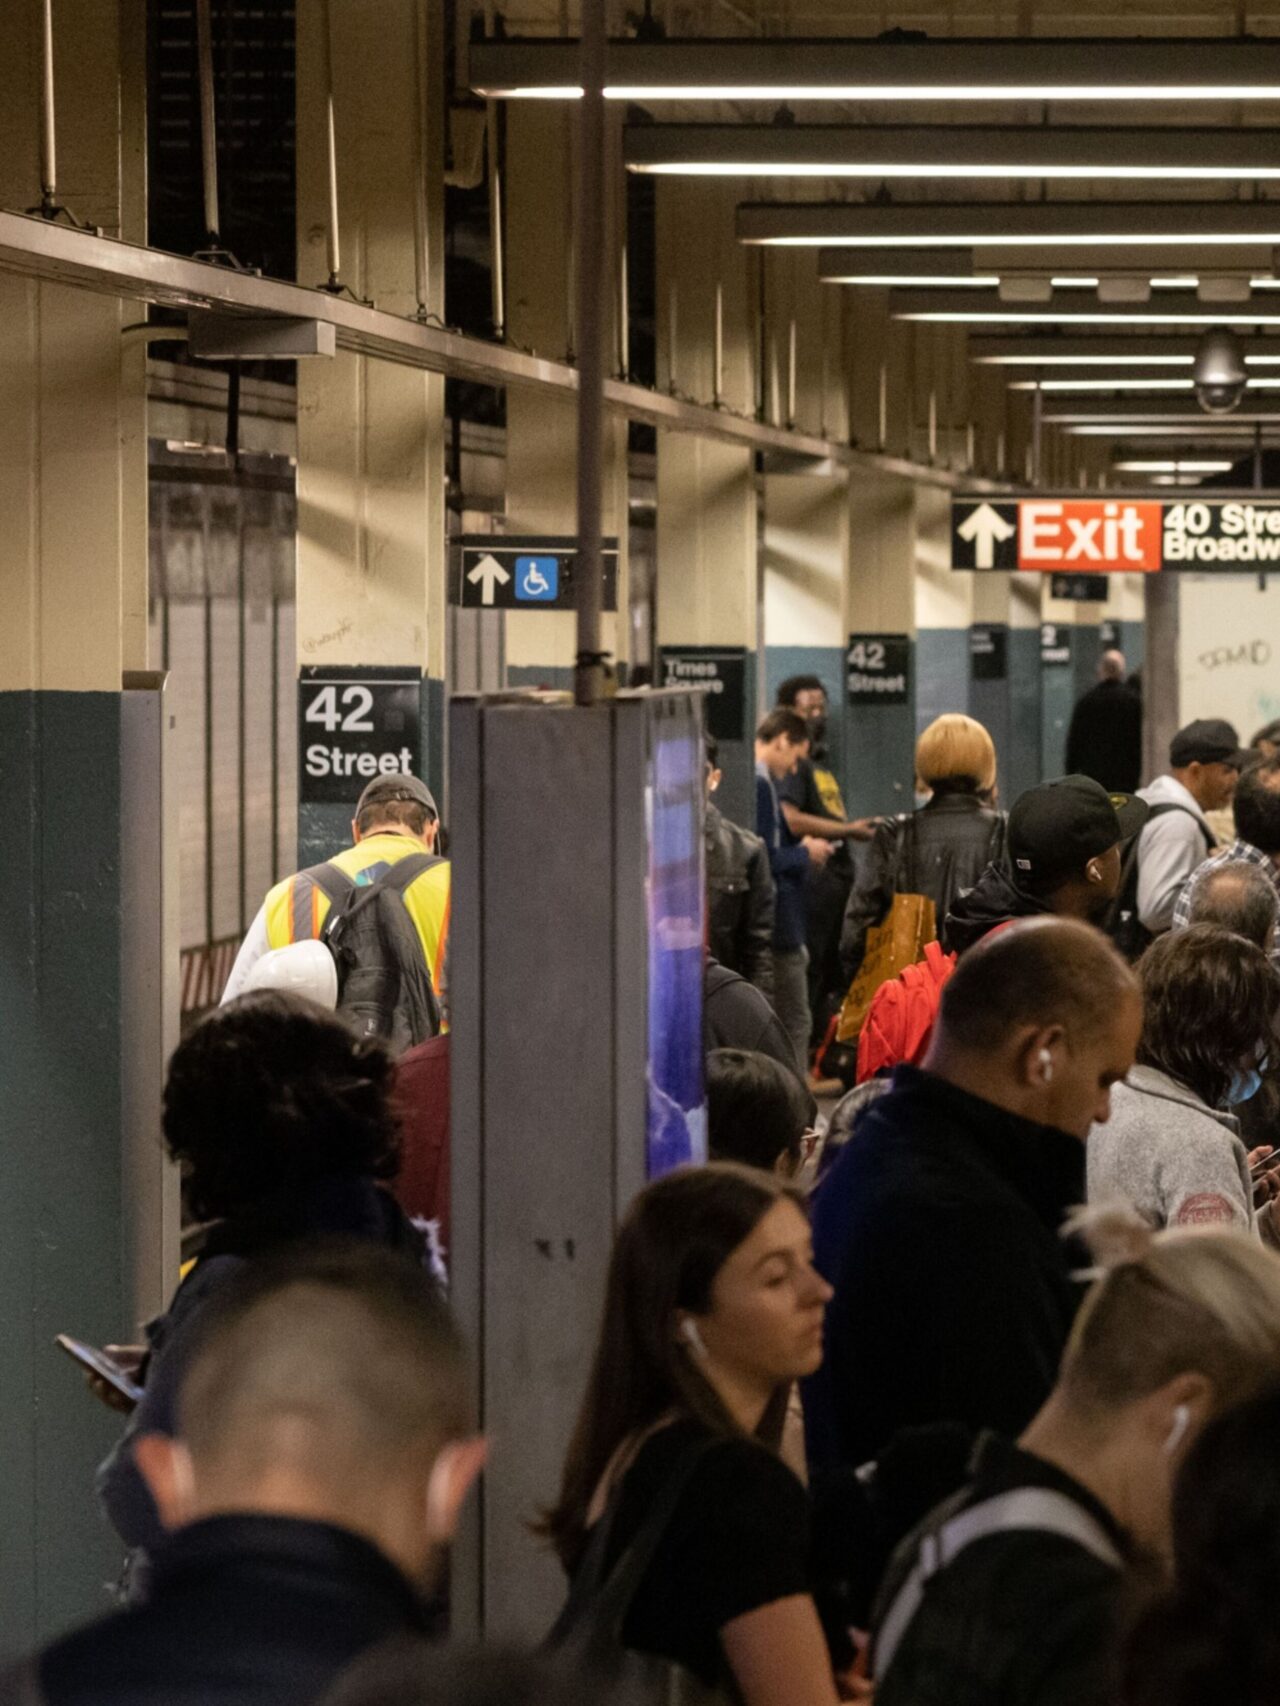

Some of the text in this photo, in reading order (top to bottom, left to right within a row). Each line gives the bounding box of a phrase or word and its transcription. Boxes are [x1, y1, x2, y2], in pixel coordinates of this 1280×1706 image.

[1020, 503, 1143, 561] Exit
[1164, 504, 1211, 534] 40
[666, 660, 717, 677] Times
[847, 643, 885, 669] 42
[849, 674, 905, 692] Street
[306, 685, 374, 732] 42
[306, 744, 412, 777] Street
